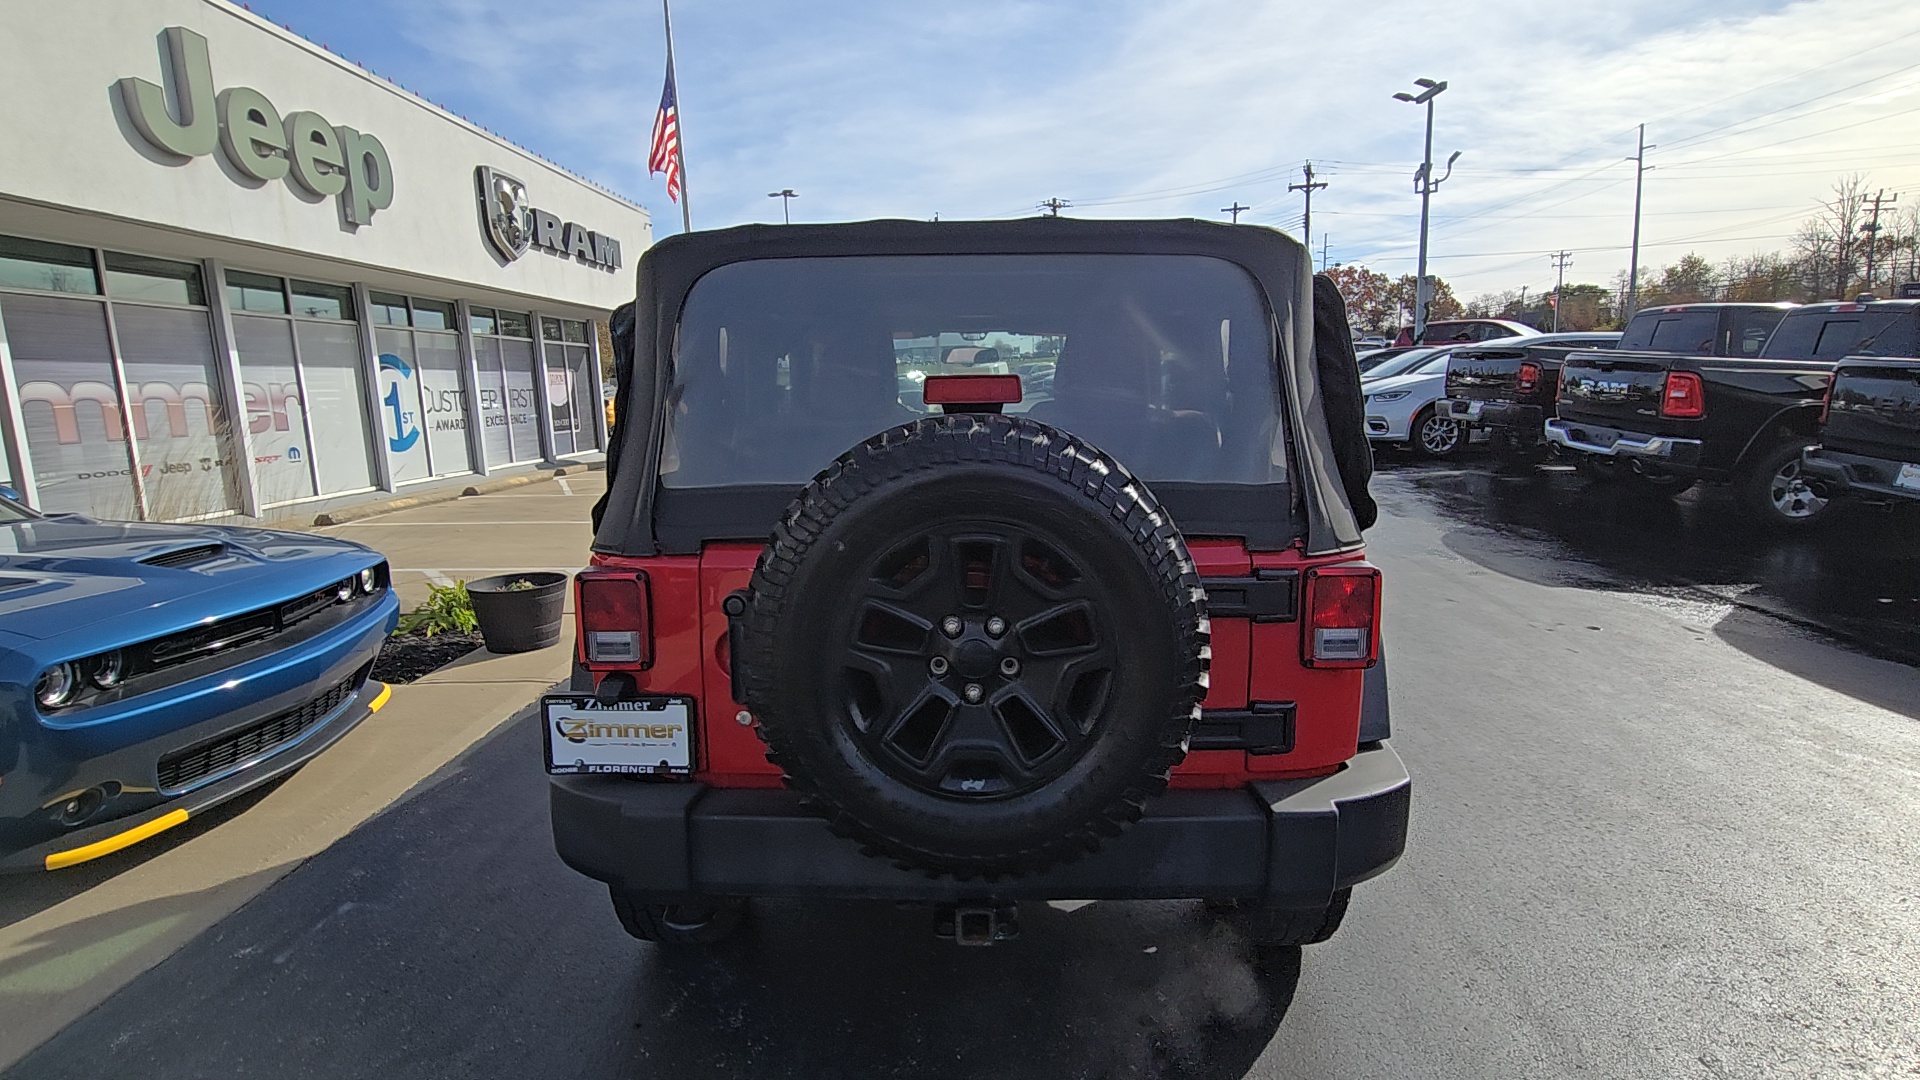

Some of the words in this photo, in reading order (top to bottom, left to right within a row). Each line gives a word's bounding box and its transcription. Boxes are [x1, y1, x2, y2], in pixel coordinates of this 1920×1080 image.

[115, 26, 394, 226] Jeep
[530, 208, 622, 270] RAM
[1580, 380, 1628, 394] RAM
[424, 385, 498, 414] CUSTOER
[501, 386, 533, 410] IRST
[436, 418, 467, 432] AWARD
[485, 413, 528, 428] EXCELENCE
[78, 469, 133, 480] DODG
[159, 460, 192, 475] Jeep
[215, 458, 237, 467] RA
[564, 718, 682, 739] Zimmer
[589, 765, 655, 774] FLORENCE
